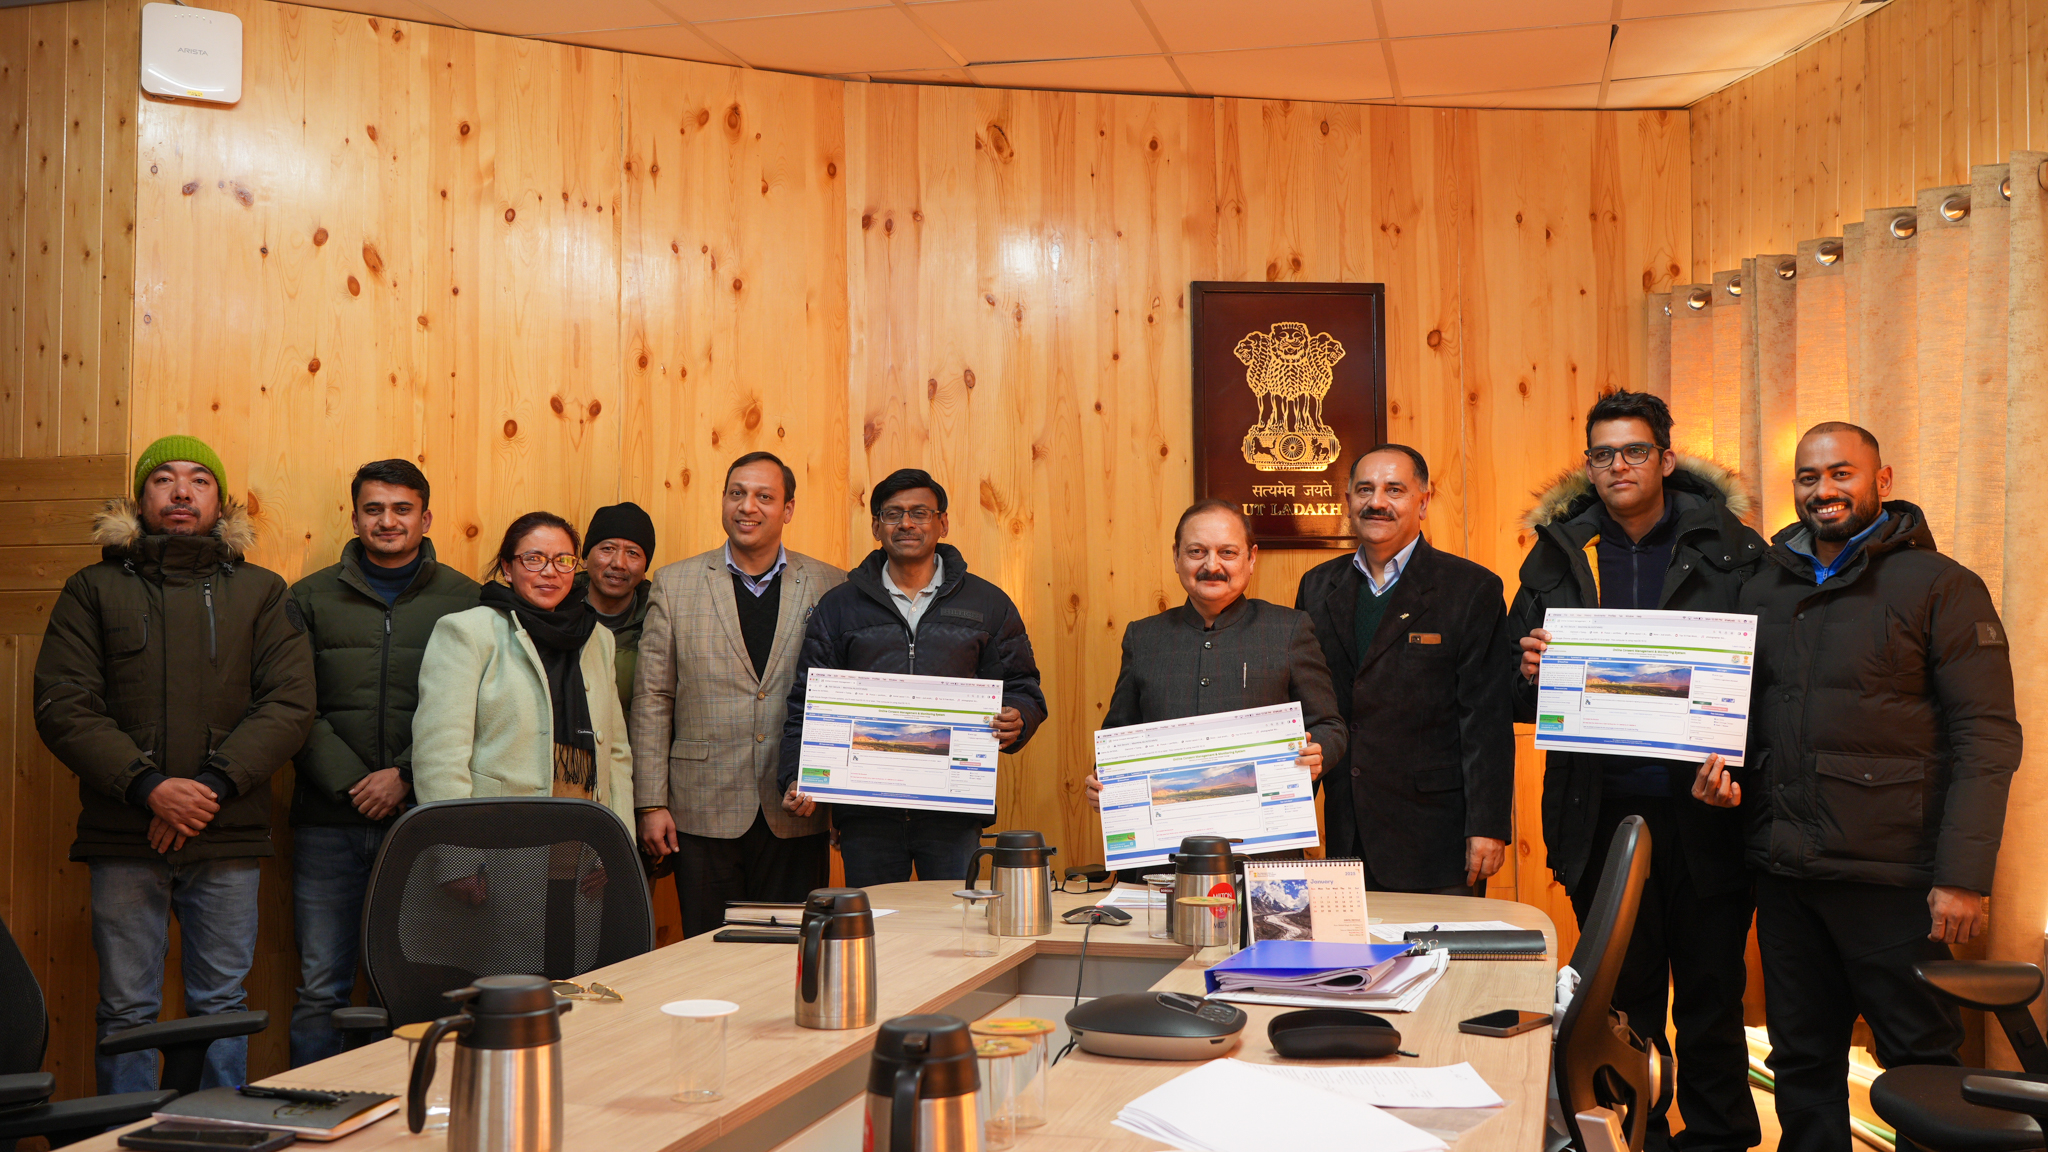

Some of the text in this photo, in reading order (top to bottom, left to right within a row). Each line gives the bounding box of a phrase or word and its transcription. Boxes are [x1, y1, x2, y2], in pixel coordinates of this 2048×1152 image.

[177, 47, 208, 56] ARISTA
[1252, 479, 1332, 497] सत्यमेव जयते
[1242, 503, 1342, 516] UT LADAKH
